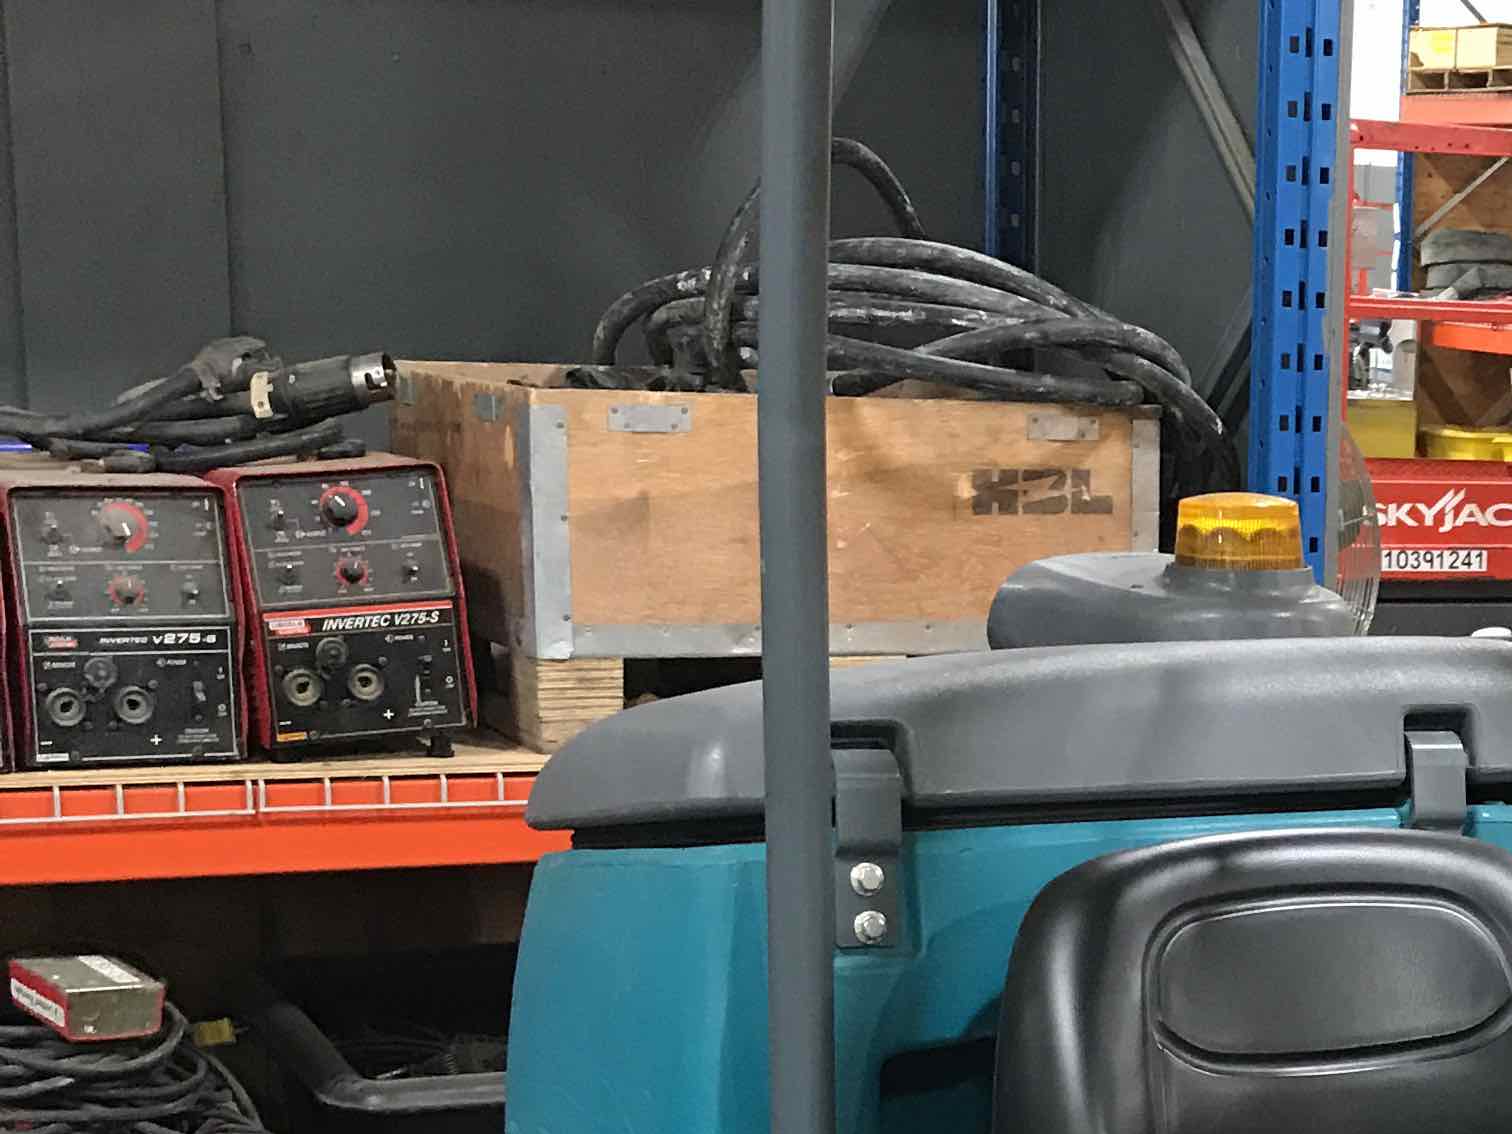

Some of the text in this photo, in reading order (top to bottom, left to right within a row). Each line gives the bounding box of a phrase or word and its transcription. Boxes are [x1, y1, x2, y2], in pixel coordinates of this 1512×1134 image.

[1384, 550, 1484, 570] 10391241
[322, 613, 391, 632] INVERTEC
[393, 610, 440, 626] V275-S
